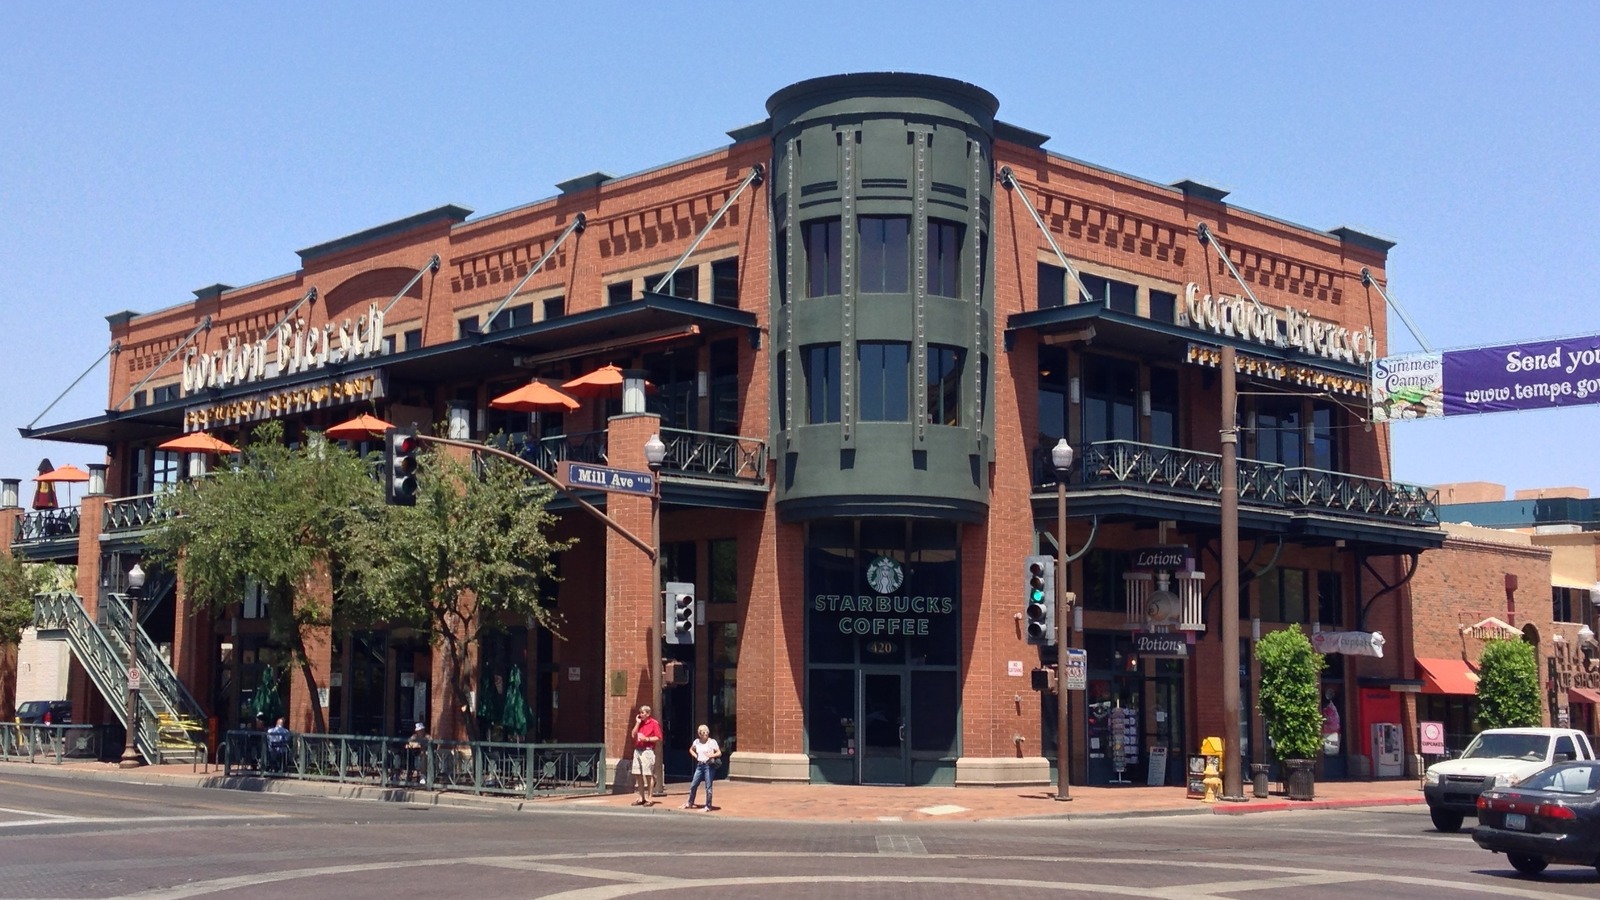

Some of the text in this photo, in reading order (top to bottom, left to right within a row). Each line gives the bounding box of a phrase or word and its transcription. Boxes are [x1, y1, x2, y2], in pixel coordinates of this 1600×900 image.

[1186, 281, 1377, 363] Gordon Biersch
[183, 301, 385, 392] Gordon Biersch
[1375, 359, 1439, 379] Summer
[1506, 347, 1562, 373] Send
[1385, 374, 1435, 394] Camps
[578, 468, 606, 484] Mill
[611, 473, 634, 488] Ave
[1136, 551, 1183, 566] Lotions
[815, 595, 953, 614] STARBUCKS
[838, 617, 930, 636] COFFEE
[870, 641, 893, 654] 420
[1137, 636, 1183, 652] Potions
